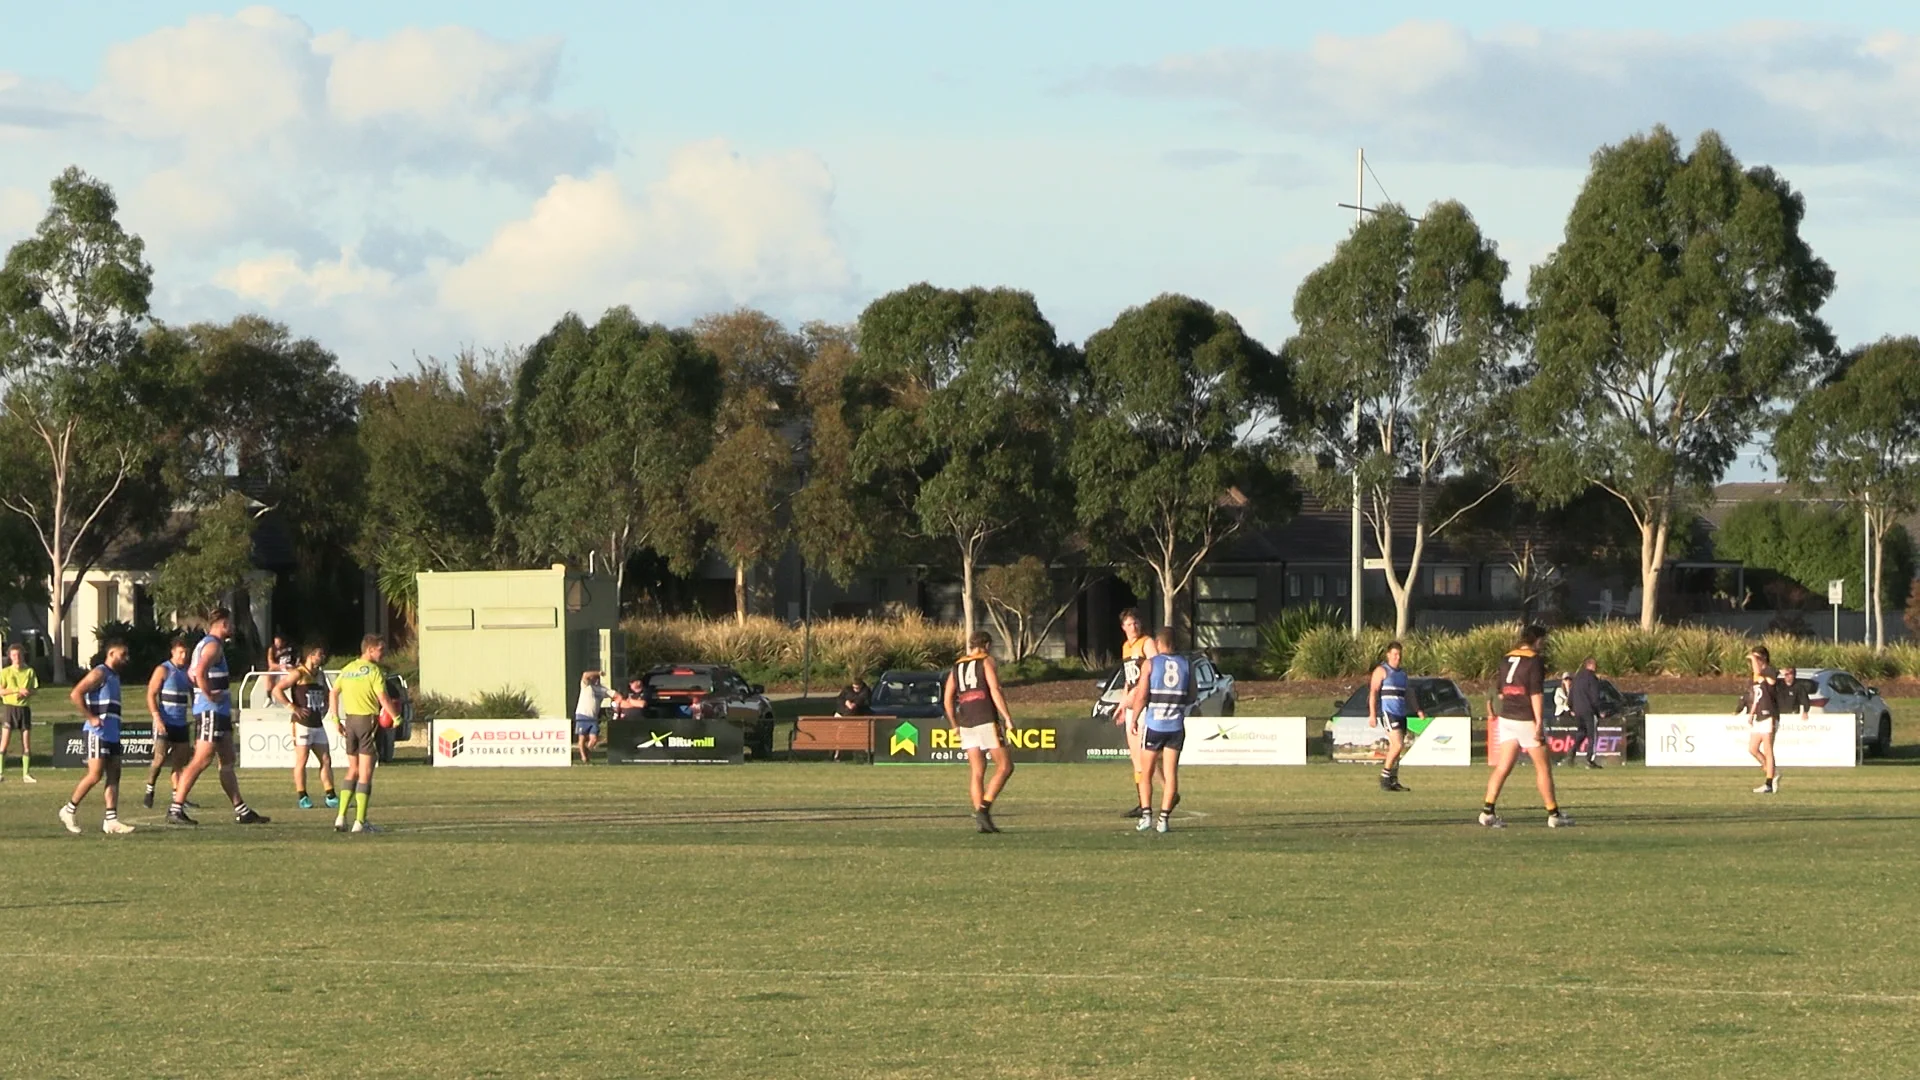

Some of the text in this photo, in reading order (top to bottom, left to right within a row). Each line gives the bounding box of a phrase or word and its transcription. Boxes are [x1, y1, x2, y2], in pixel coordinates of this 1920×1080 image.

[958, 660, 977, 691] 14
[1163, 660, 1179, 688] 8
[1506, 656, 1521, 684] 7
[470, 730, 566, 740] ABSOLUTE
[931, 729, 1056, 748] RENCE
[65, 744, 87, 755] FRE
[123, 744, 149, 755] TRIAL
[469, 747, 567, 755] STORAGE SYSTEMS
[930, 750, 992, 760] real ese
